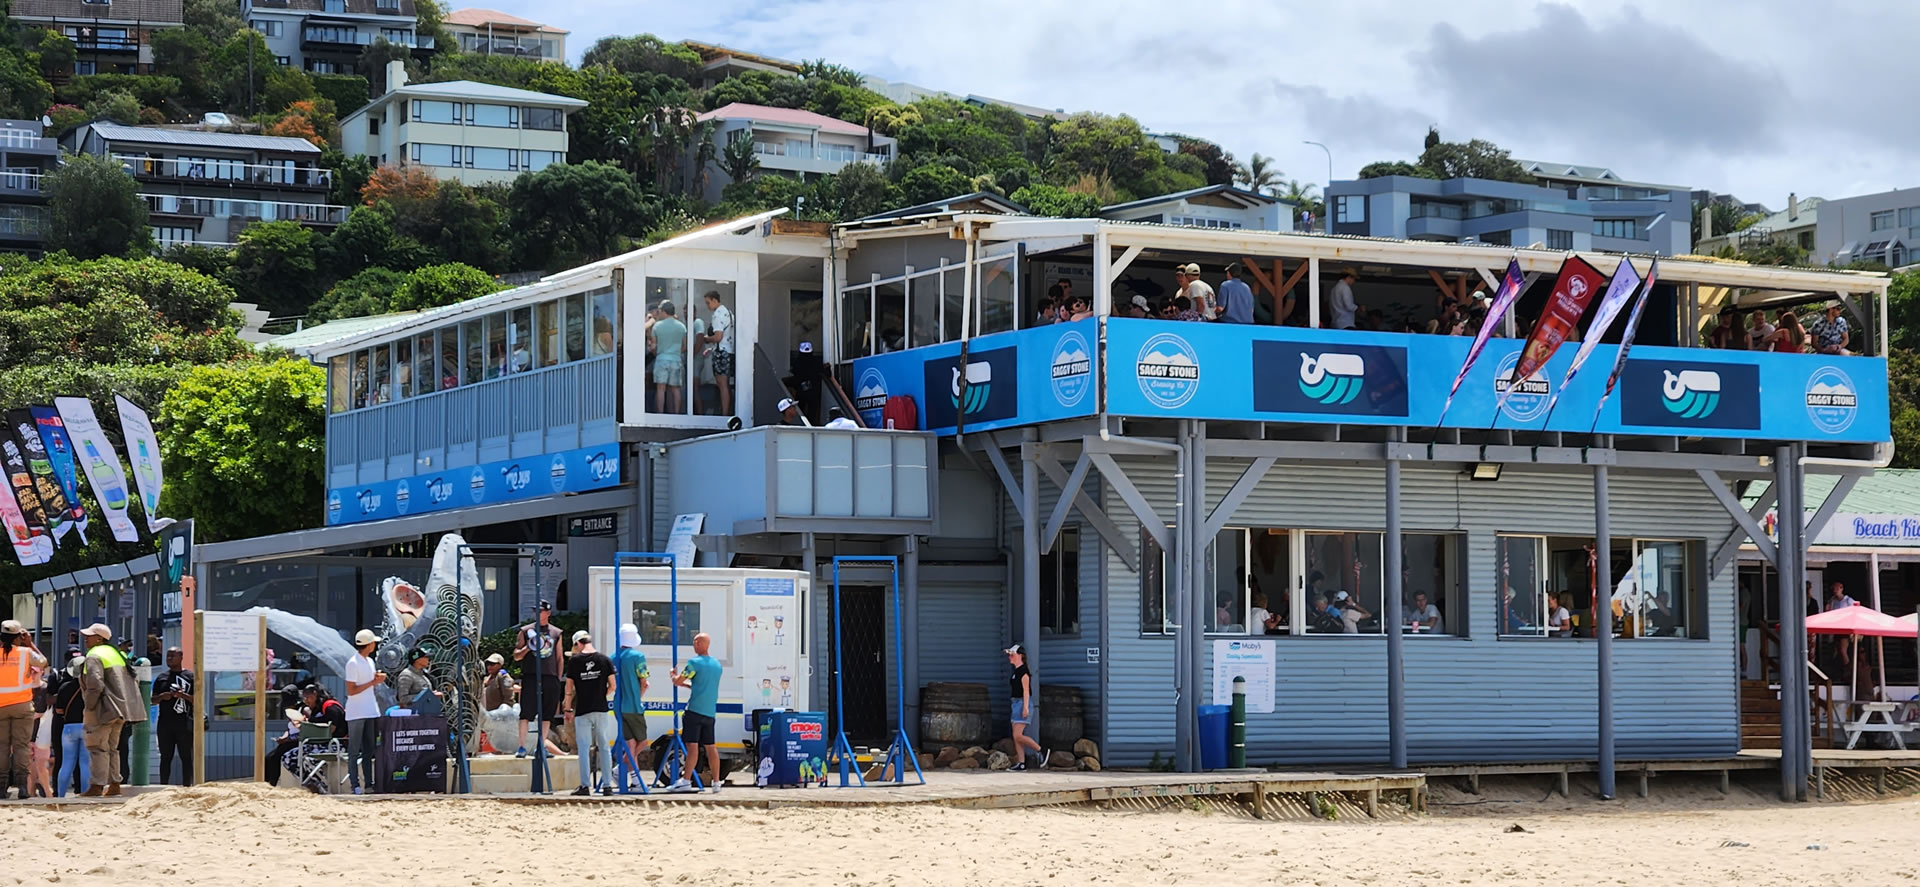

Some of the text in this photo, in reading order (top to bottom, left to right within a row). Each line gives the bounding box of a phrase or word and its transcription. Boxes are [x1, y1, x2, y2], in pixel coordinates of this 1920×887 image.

[1053, 361, 1089, 377] SAGGY STONE
[1139, 364, 1197, 378] SAGGY STONE
[1522, 382, 1548, 392] STONE
[1808, 395, 1855, 405] SAGGY STONE
[584, 517, 612, 531] ENTRANCE
[1853, 517, 1897, 537] Beach
[530, 558, 561, 569] Moby's
[1241, 642, 1262, 651] Moby's
[790, 722, 822, 734] STRONG
